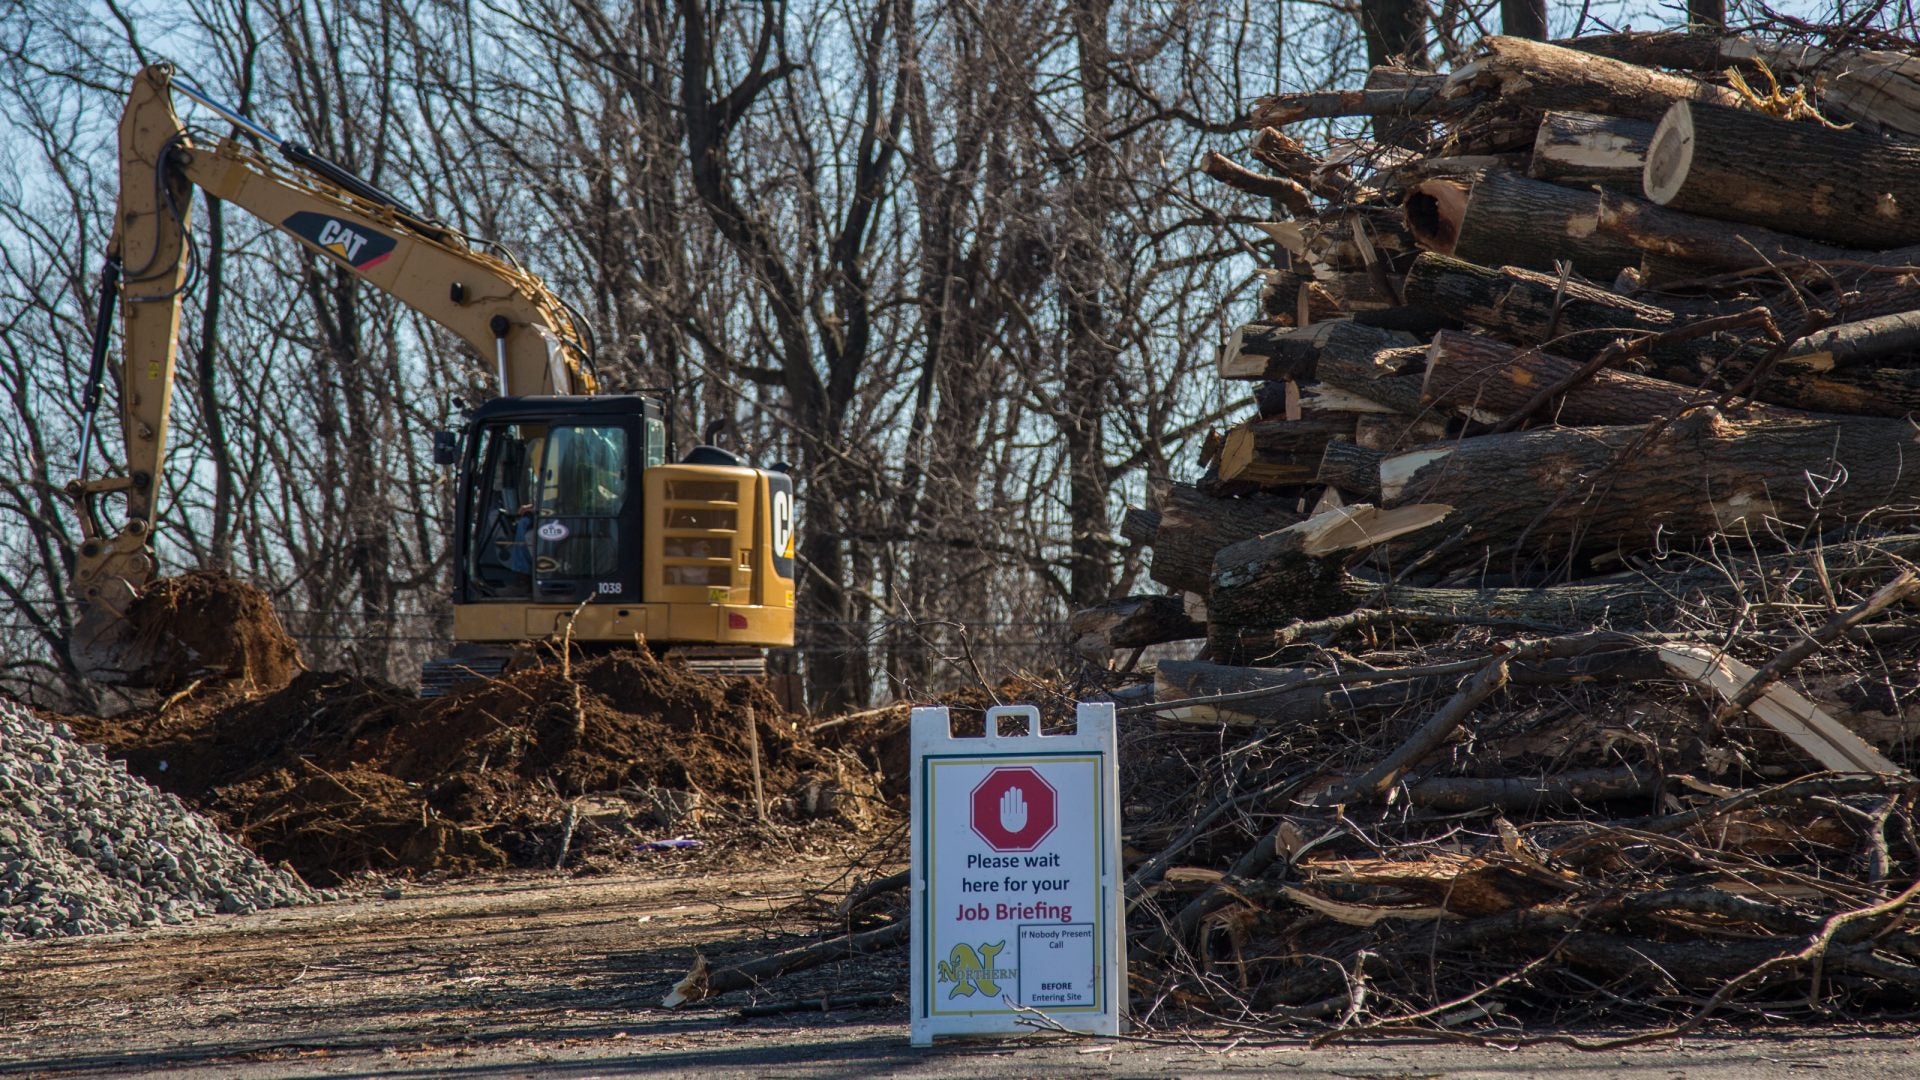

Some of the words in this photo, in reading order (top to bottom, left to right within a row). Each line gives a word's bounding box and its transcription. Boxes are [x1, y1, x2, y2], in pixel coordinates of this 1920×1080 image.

[318, 219, 368, 262] CAT
[598, 582, 622, 594] 1038
[967, 853, 1019, 869] Please
[1024, 852, 1060, 867] wait
[962, 877, 999, 893] here
[1004, 876, 1027, 892] for
[1032, 879, 1070, 894] your
[956, 902, 990, 921] Job
[996, 901, 1072, 923] Briefing
[1021, 931, 1027, 939] If
[1029, 930, 1060, 940] Nobody
[1061, 930, 1091, 938] Present
[1049, 941, 1064, 949] Call
[938, 960, 1018, 983] NORTHERN
[1041, 982, 1073, 991] BEFORE
[1032, 993, 1065, 1002] Entering
[1067, 992, 1082, 1001] Site
